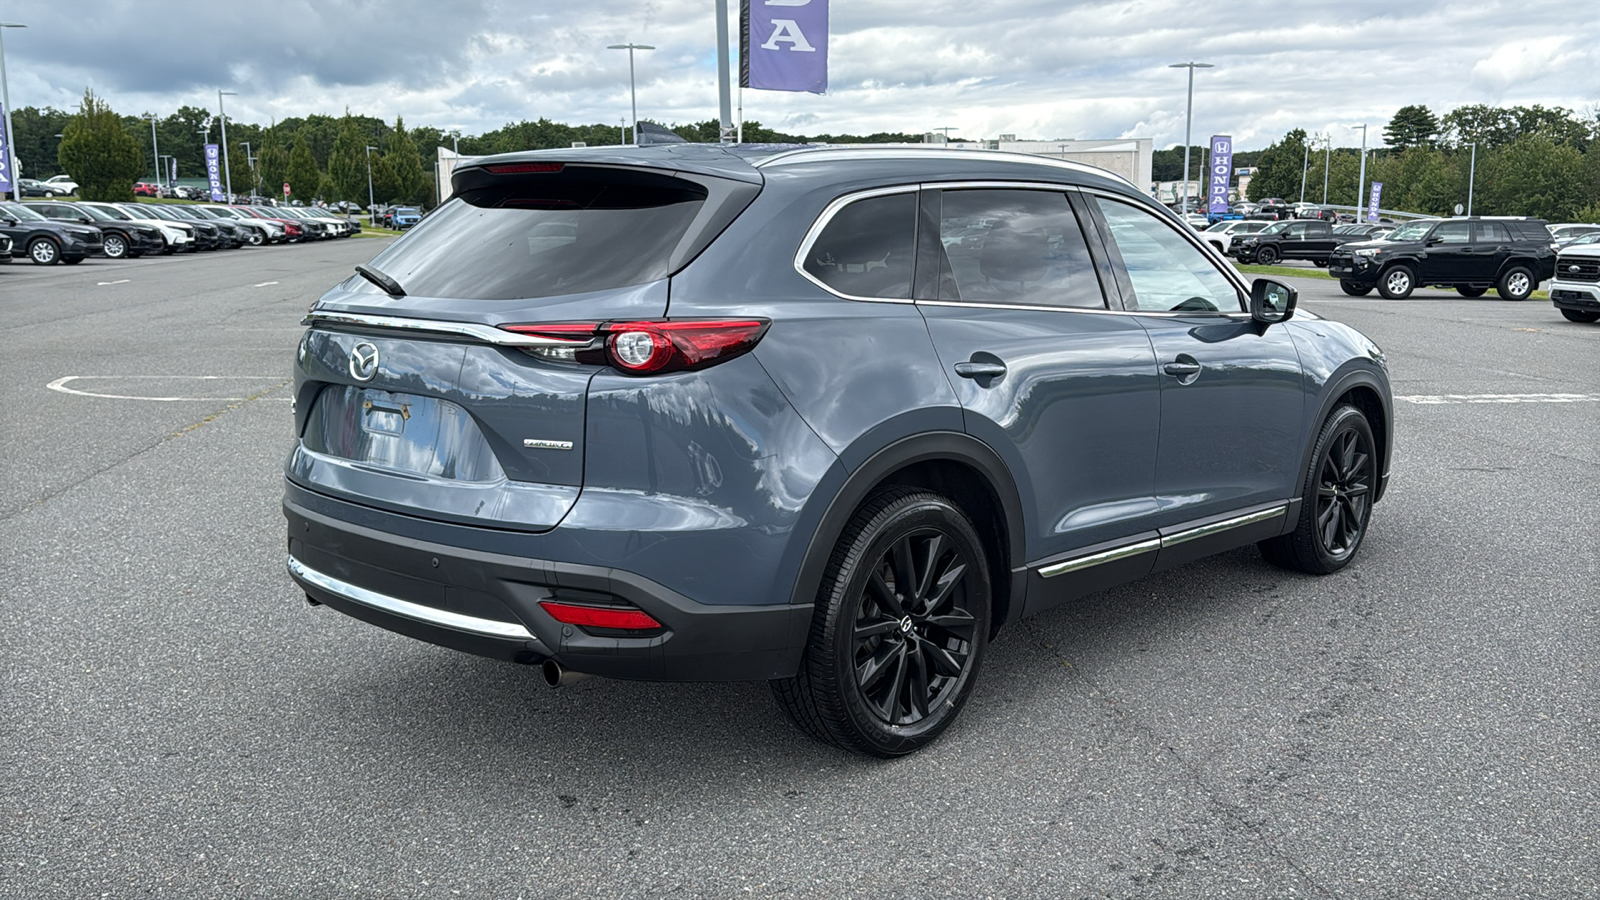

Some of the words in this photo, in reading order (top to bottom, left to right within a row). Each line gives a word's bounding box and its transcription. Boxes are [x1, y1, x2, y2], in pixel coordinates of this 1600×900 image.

[761, 0, 817, 52] A
[208, 159, 221, 195] HONDA
[1211, 156, 1229, 205] HONDA
[1370, 192, 1379, 217] HONDA
